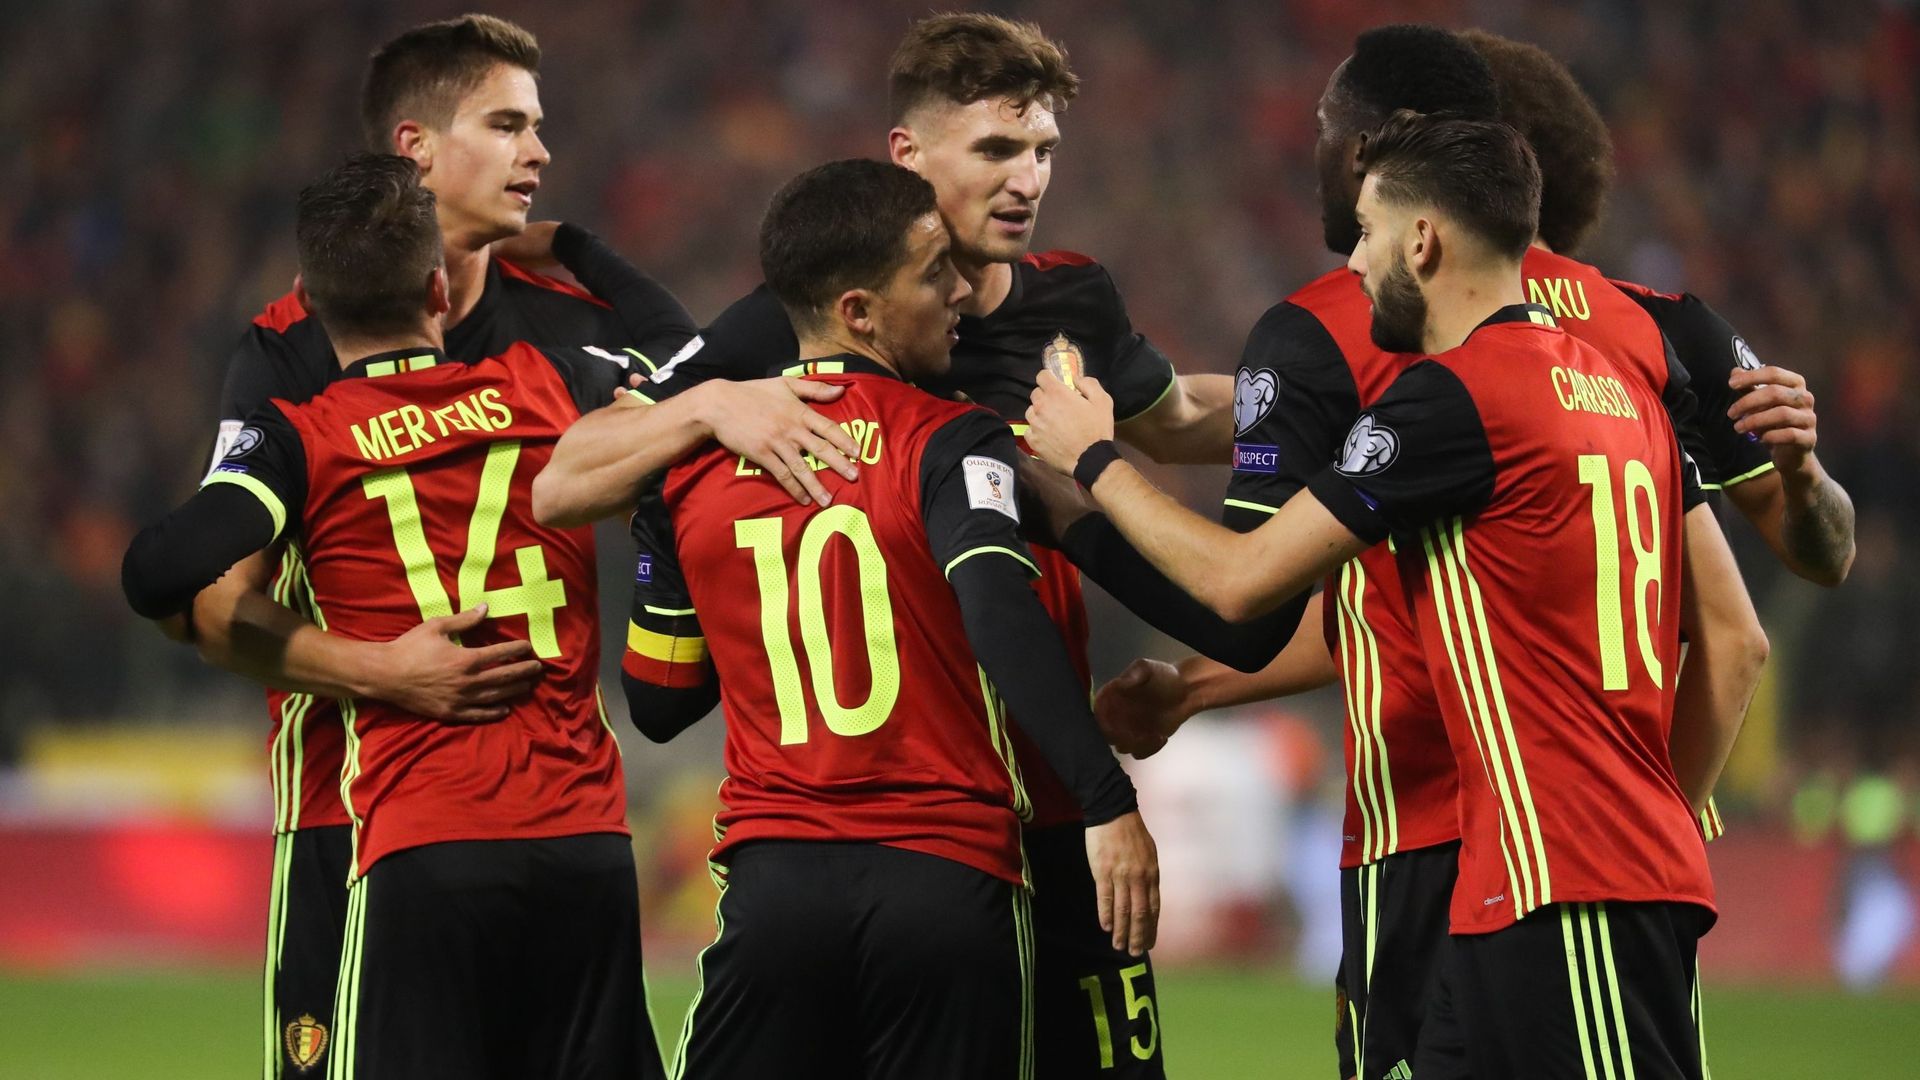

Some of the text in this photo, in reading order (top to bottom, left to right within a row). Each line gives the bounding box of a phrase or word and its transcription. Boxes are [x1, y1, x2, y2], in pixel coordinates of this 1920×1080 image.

[361, 439, 568, 659] 14
[1240, 451, 1278, 466] RESPECT
[734, 504, 901, 746] 10
[1578, 455, 1663, 691] 18
[1079, 962, 1159, 1069] 15
